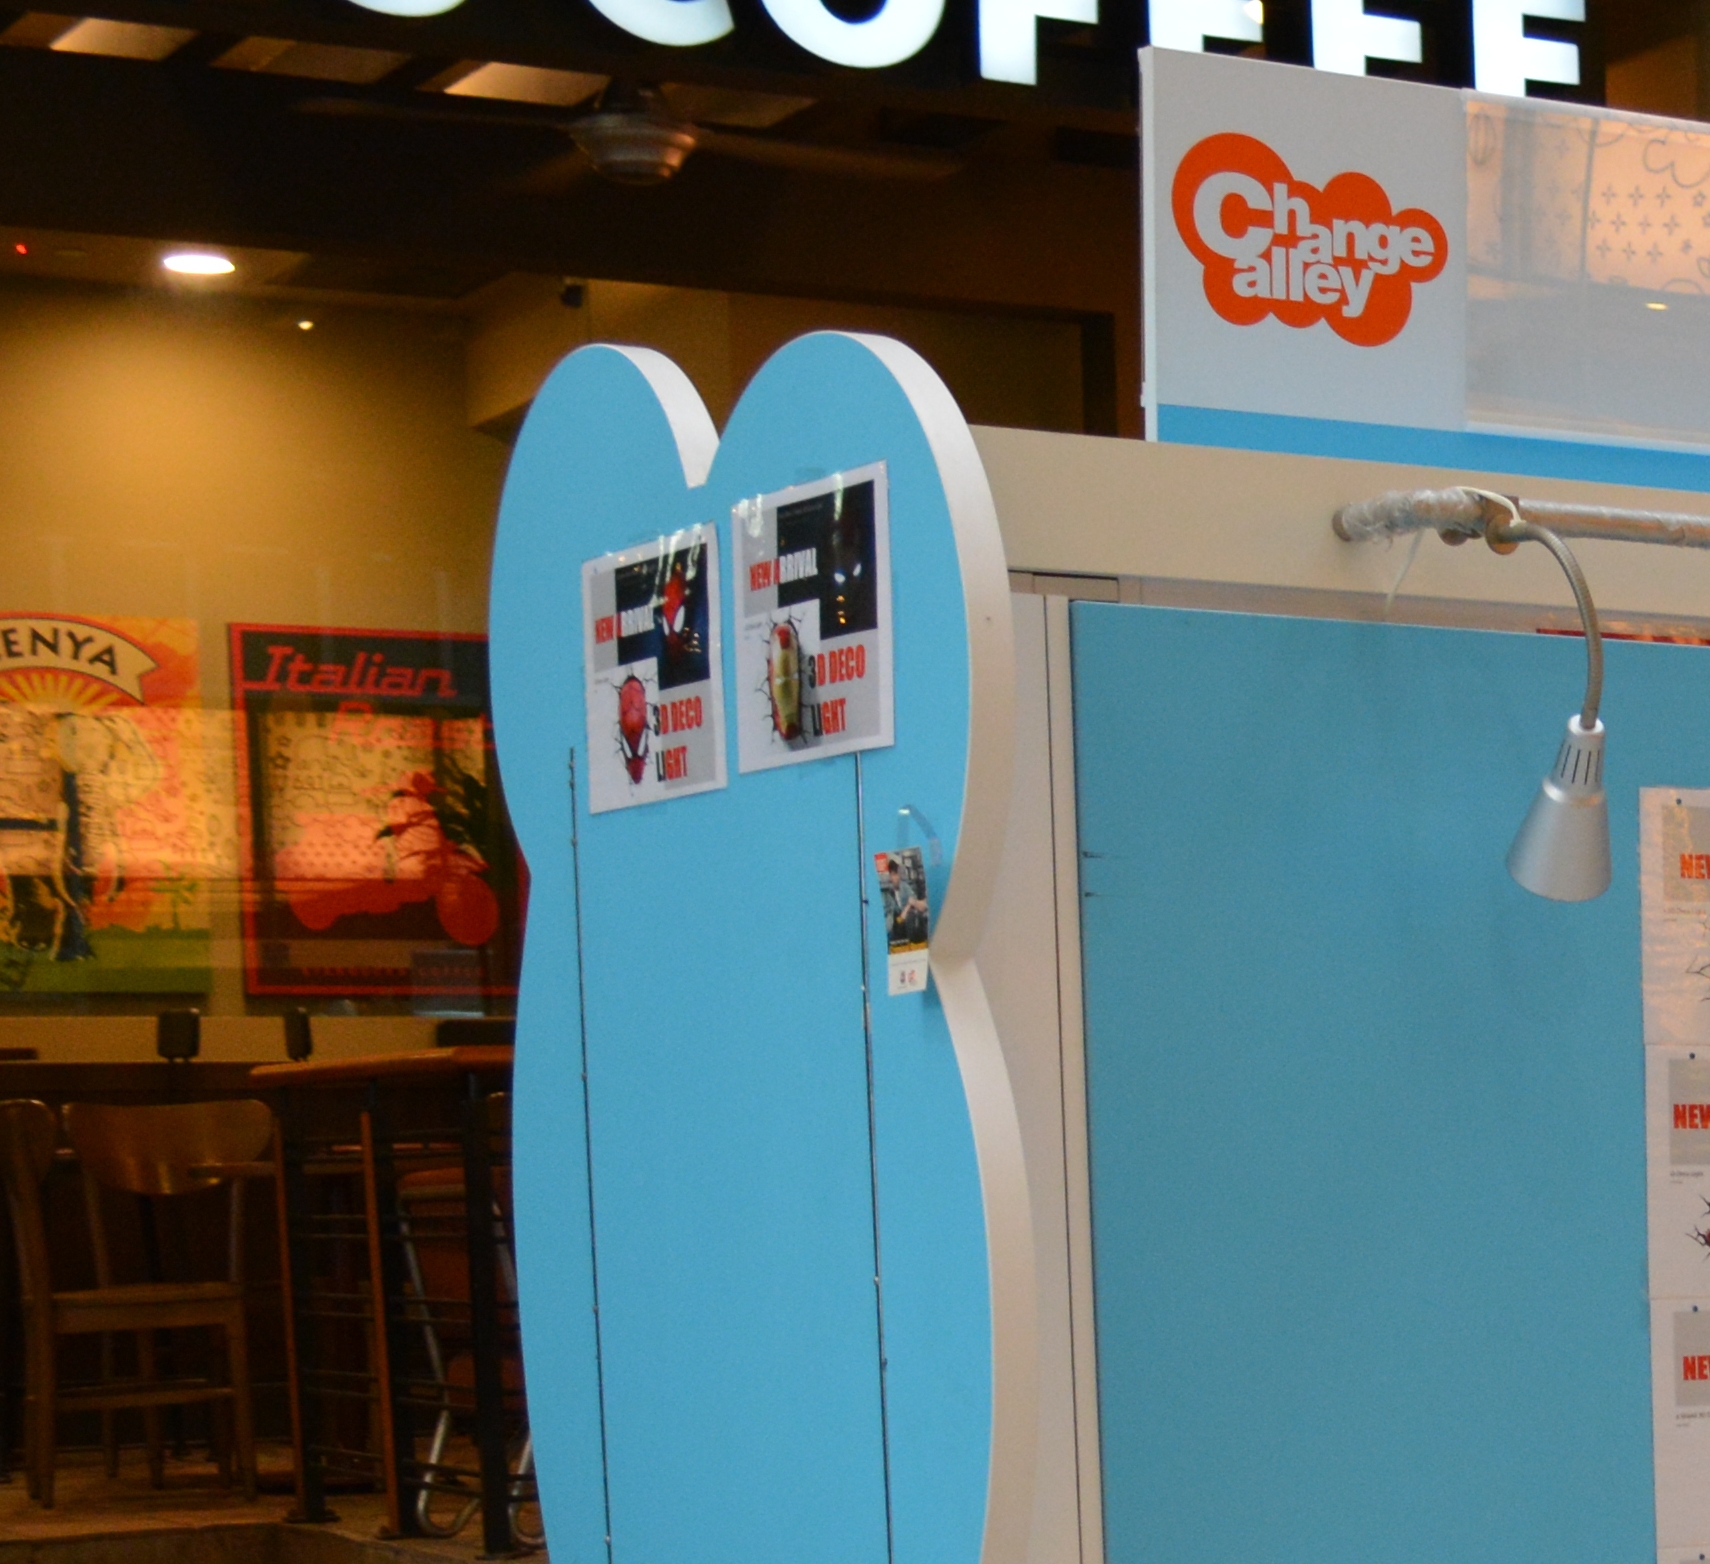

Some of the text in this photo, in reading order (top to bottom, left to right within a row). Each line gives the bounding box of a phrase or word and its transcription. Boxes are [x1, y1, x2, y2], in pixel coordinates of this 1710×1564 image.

[1193, 171, 1435, 275] Change
[1232, 246, 1375, 317] alley
[0, 627, 118, 676] ENYA
[264, 644, 458, 699] Italian
[808, 644, 866, 688] 3D DECO
[811, 697, 846, 736] LIGHT
